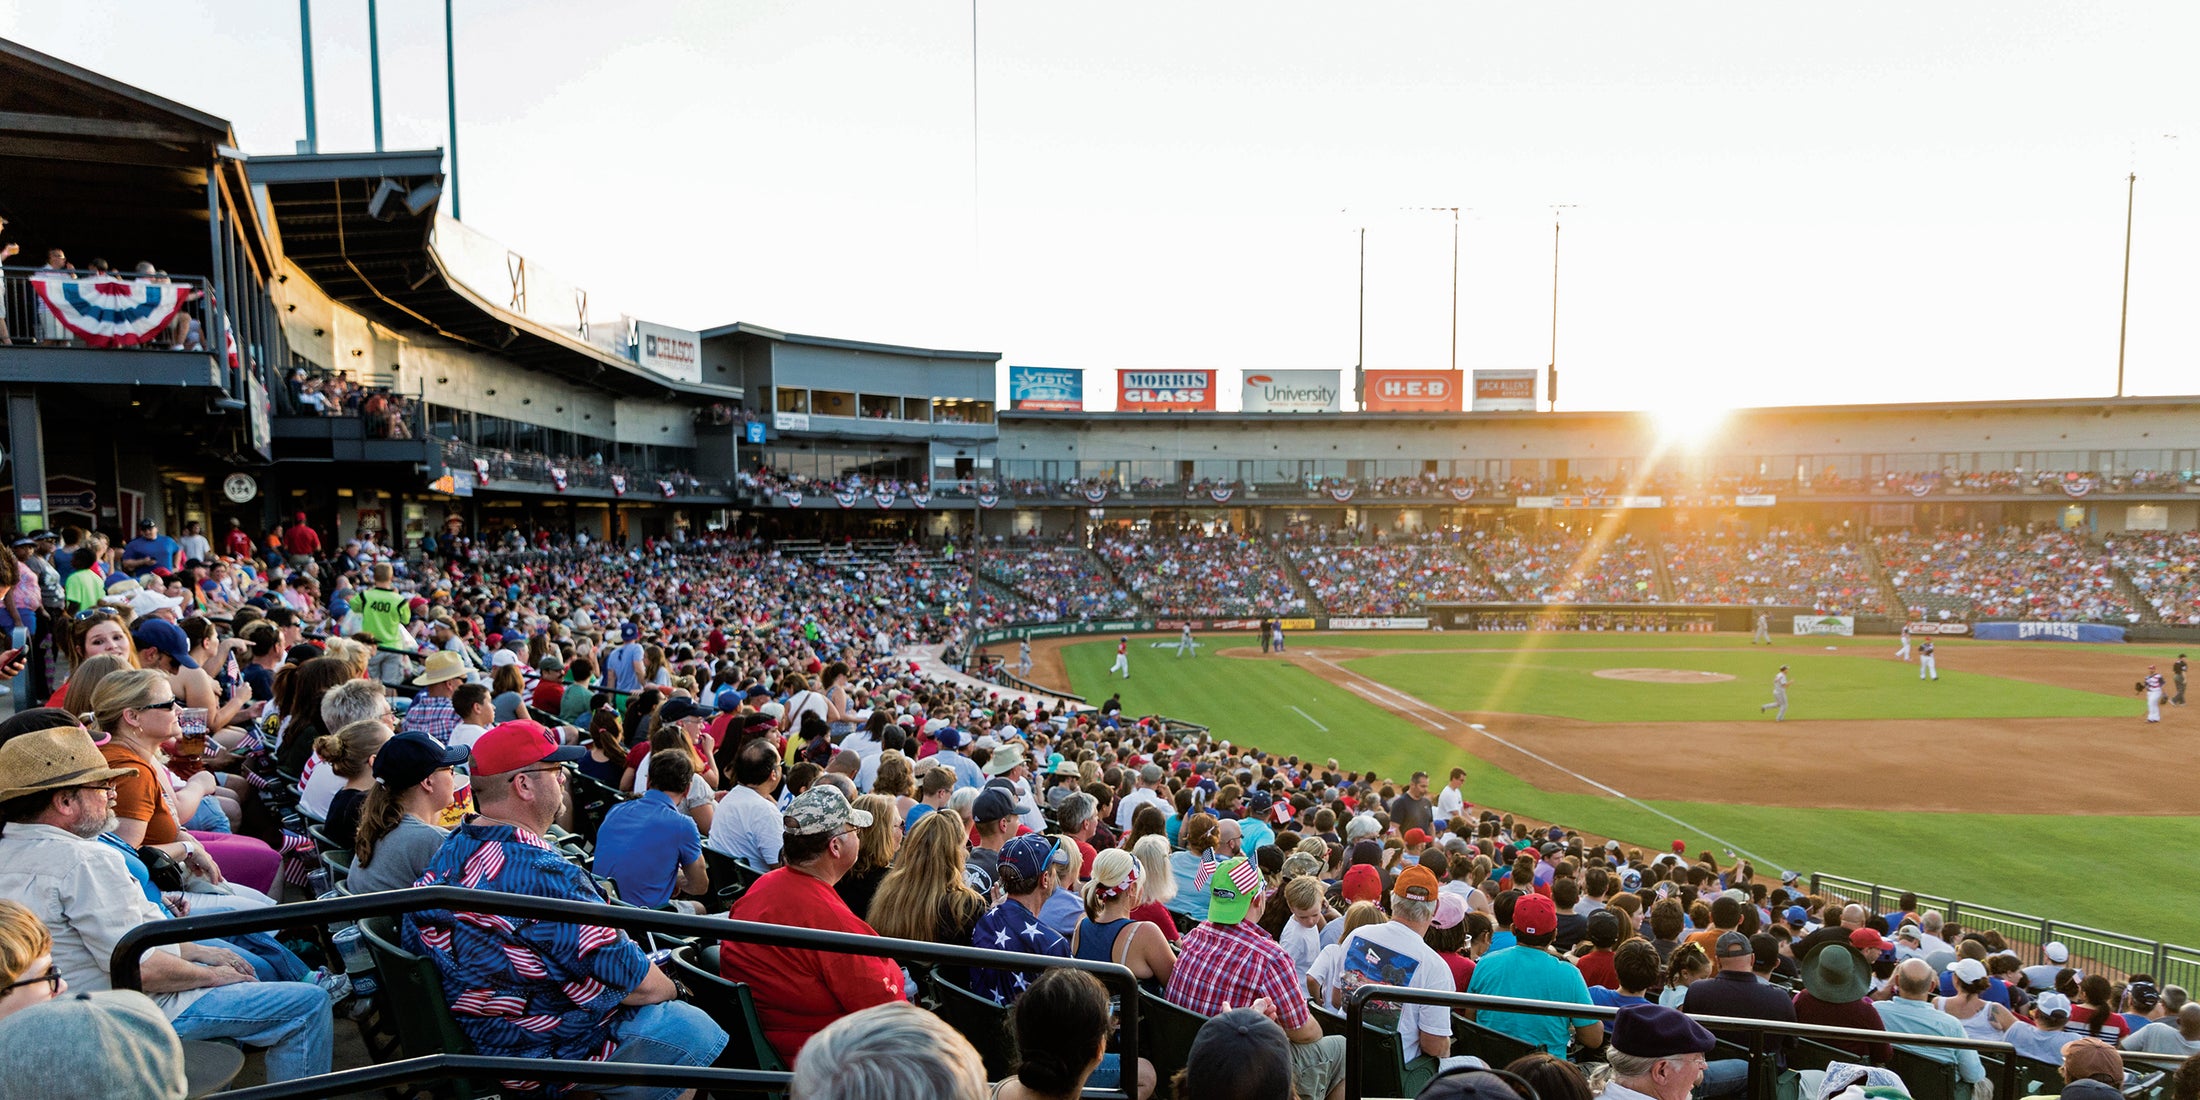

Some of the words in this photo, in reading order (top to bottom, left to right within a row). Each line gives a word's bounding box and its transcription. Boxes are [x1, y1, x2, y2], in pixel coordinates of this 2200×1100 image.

[657, 337, 695, 363] CHASCO
[1034, 372, 1074, 385] TSTC
[1128, 374, 1205, 387] MORRIS
[1124, 389, 1205, 403] GLASS
[1264, 385, 1337, 407] University
[370, 600, 391, 613] 400
[2019, 621, 2078, 640] EXPRESS
